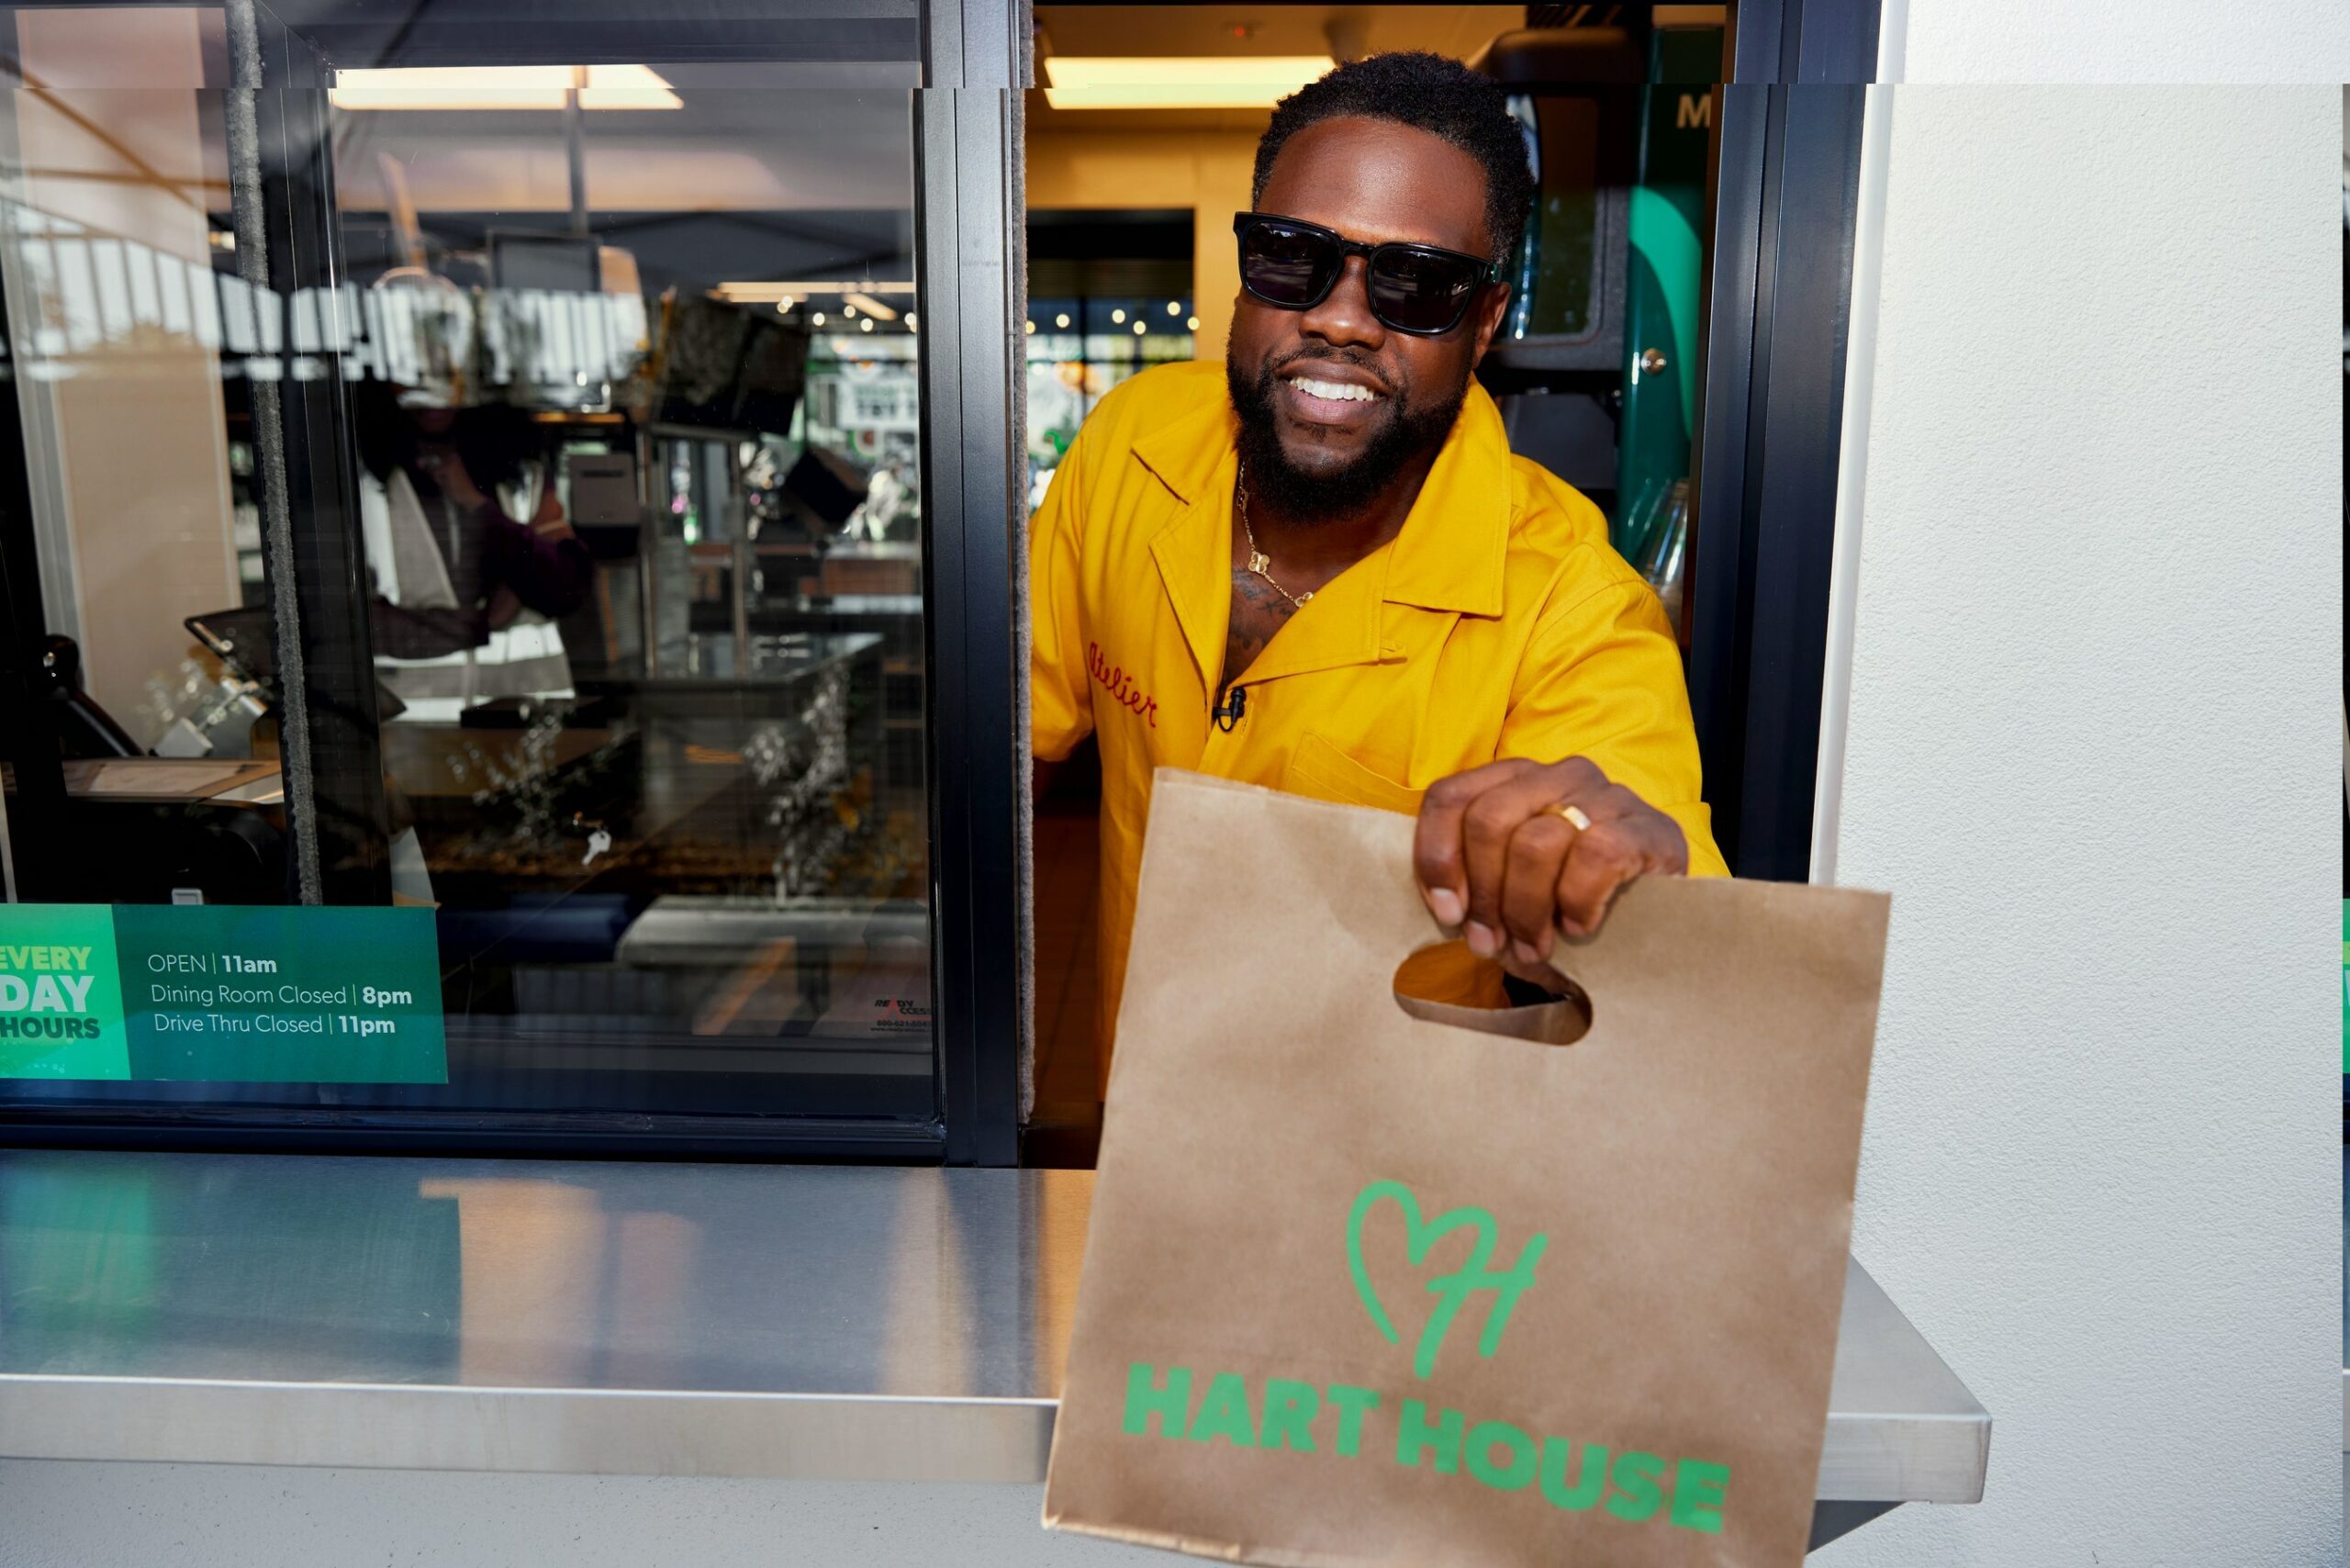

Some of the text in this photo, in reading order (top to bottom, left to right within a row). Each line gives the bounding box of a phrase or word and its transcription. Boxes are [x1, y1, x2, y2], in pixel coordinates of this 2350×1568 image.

[148, 954, 277, 973] OPEN 11am
[0, 974, 95, 1013] DAY
[151, 984, 412, 1008] Dining Room Closed 8pm
[0, 1016, 101, 1039] HOURS
[154, 1014, 396, 1037] Drive Thru Closed 11pm
[1123, 1362, 1731, 1535] HART HOUSE
